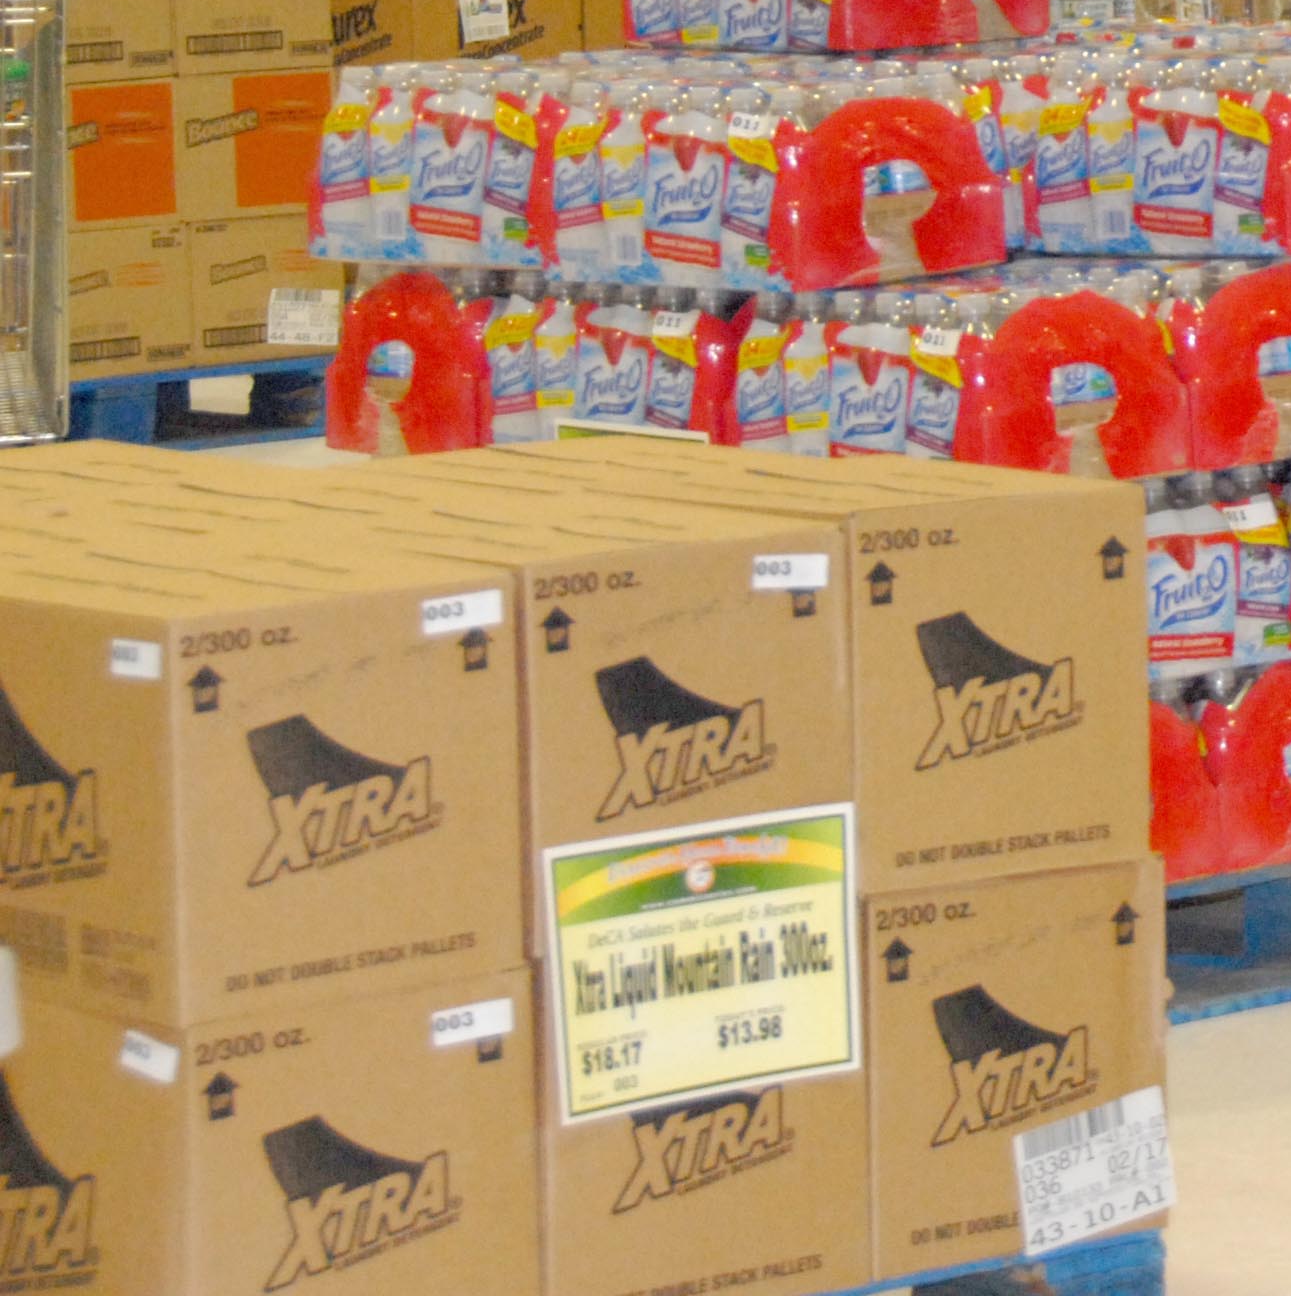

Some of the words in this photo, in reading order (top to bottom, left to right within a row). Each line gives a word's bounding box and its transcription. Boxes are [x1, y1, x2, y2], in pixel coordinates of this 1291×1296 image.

[185, 108, 260, 148] Bounce
[859, 528, 920, 554] 2/300
[927, 527, 959, 547] oz.
[534, 571, 599, 601] 2/300
[608, 570, 642, 591] oz.
[755, 561, 793, 576] 003
[425, 601, 465, 621] 003
[179, 628, 251, 659] 2/300
[260, 625, 299, 645] oz.
[913, 656, 1074, 772] XTRA
[595, 697, 765, 824] XTRA
[246, 755, 431, 890] XTRA
[1007, 832, 1052, 853] STACK
[1054, 824, 1111, 843] PALLETS
[876, 902, 937, 932] 2/300
[944, 901, 977, 922] oz.
[355, 946, 408, 969] STACK
[410, 932, 478, 958] PALLETS
[609, 945, 658, 1021] Liquid
[662, 933, 736, 1000] Mountain
[740, 928, 776, 985] Rain
[434, 1011, 475, 1033] 003
[195, 1032, 266, 1067] 2/300
[273, 1027, 312, 1049] oz.
[582, 1040, 643, 1076] $18.17
[717, 1015, 784, 1049] $13.98
[931, 1024, 1088, 1149] XTRA
[610, 1084, 784, 1216] XTRA
[1021, 1142, 1096, 1184] 033871
[1106, 1141, 1168, 1175] 02/17
[1024, 1175, 1062, 1204] 036
[263, 1150, 449, 1294] XTRA
